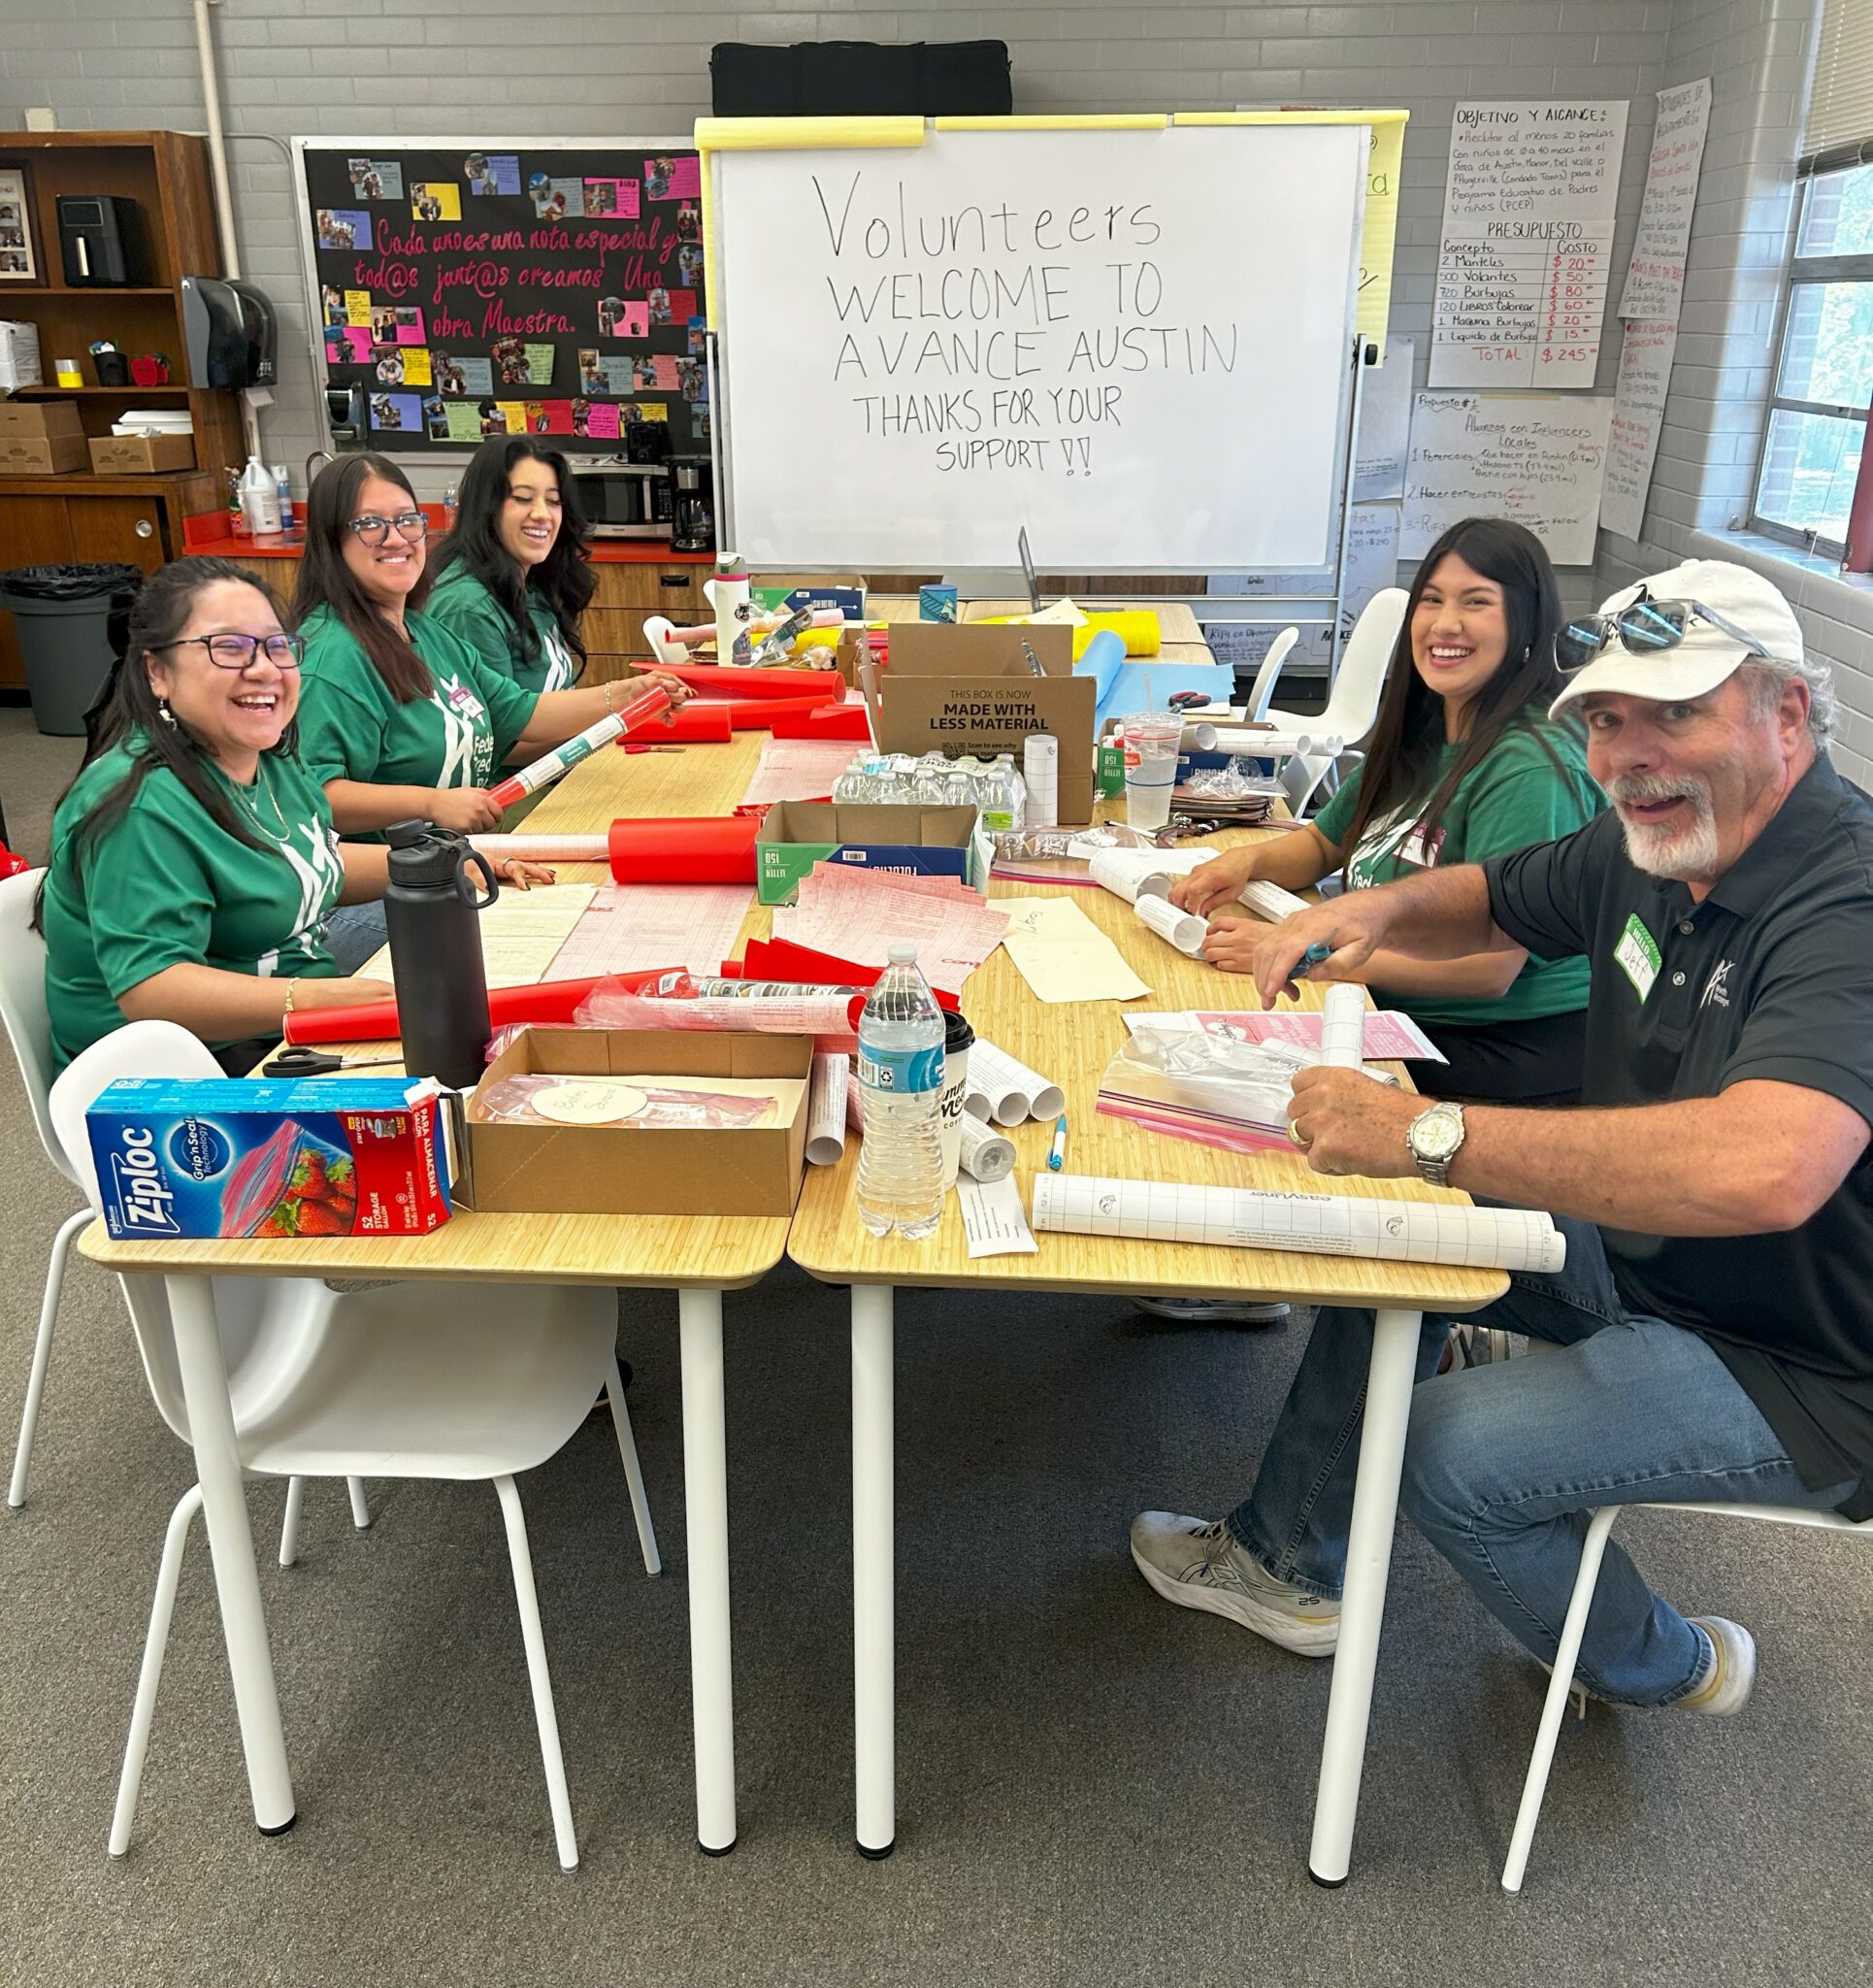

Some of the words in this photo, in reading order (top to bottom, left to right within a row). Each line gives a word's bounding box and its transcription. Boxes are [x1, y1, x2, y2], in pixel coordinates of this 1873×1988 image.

[1457, 110, 1519, 128] OBJETIVO
[1528, 110, 1538, 121] Y
[1507, 130, 1519, 142] al
[1525, 132, 1558, 141] menos
[1562, 131, 1576, 140] 20
[1503, 147, 1515, 155] de
[1594, 142, 1605, 151] el
[1478, 160, 1491, 171] de
[1570, 171, 1592, 182] para
[1594, 167, 1604, 178] el
[1452, 186, 1495, 204] Programa
[1549, 185, 1562, 195] de
[1568, 183, 1598, 194] Padres
[1499, 198, 1534, 212] (PCEP)
[812, 171, 1161, 258] Volunteers
[1487, 221, 1583, 240] PRESUPUESTO
[377, 218, 427, 256] Cada
[530, 225, 571, 251] nota
[575, 215, 661, 269] especial
[658, 232, 678, 265] y
[1443, 239, 1495, 257] Concepto
[1442, 256, 1450, 266] 2
[354, 257, 419, 298] tod@s
[433, 259, 510, 305] junt@s
[518, 265, 604, 288] creamos
[624, 253, 665, 291] Una
[1439, 272, 1460, 282] 500
[1463, 270, 1517, 282] Volantes
[827, 265, 1070, 325] WELCOME
[1105, 262, 1163, 316] TO
[1463, 285, 1515, 301] Burbujas
[1439, 302, 1456, 312] 120
[433, 305, 475, 339] obra
[481, 298, 576, 339] Maestra.
[1490, 330, 1501, 340] de
[835, 330, 1047, 381] AVANCE
[1068, 323, 1237, 375] AUSTIN
[853, 389, 982, 436] THANKS
[993, 387, 1040, 427] FOR
[1047, 385, 1122, 427] YOUR
[936, 438, 1051, 471] SUPPORT
[1420, 487, 1449, 499] Hacer
[950, 690, 970, 699] THIS
[973, 690, 992, 699] BOX
[996, 690, 1004, 699] IS
[1006, 690, 1031, 699] NOW
[944, 704, 990, 715] MADE
[994, 704, 1035, 715] WITH
[930, 718, 966, 730] LESS
[970, 718, 1048, 730] MATERIAL
[765, 852, 779, 864] 150
[766, 869, 785, 878] LETTER
[1632, 929, 1650, 955] HELLO
[1625, 944, 1648, 981] Jeff
[419, 1109, 430, 1134] PARA
[186, 1119, 198, 1145] Seal
[198, 1125, 212, 1173] Technology
[120, 1127, 174, 1223] Ziploc
[423, 1138, 438, 1197] ALMACENAR
[370, 1192, 383, 1229] STORAGE
[380, 1206, 389, 1229] GALLON
[362, 1216, 374, 1229] 52
[427, 1212, 437, 1228] 52
[1298, 1597, 1321, 1607] 25
